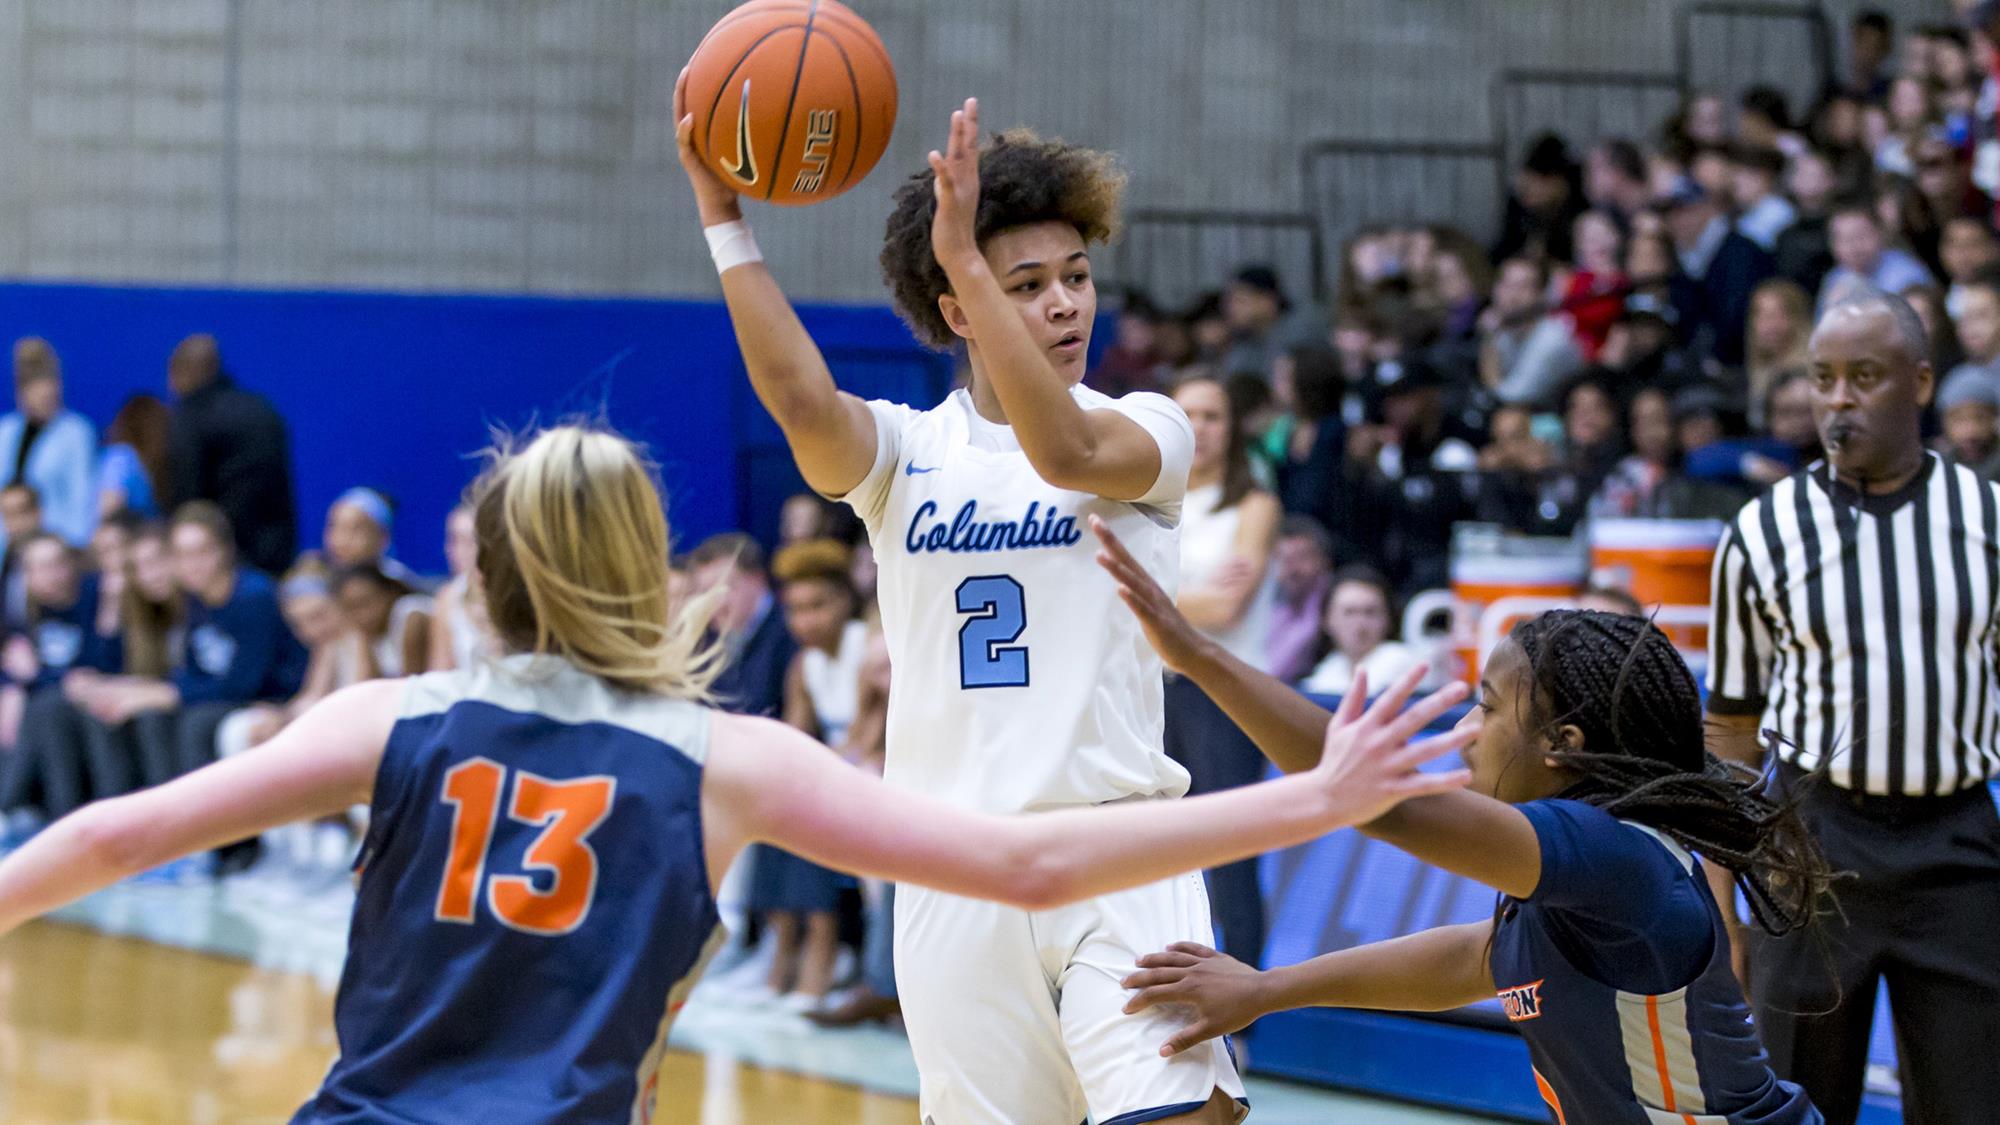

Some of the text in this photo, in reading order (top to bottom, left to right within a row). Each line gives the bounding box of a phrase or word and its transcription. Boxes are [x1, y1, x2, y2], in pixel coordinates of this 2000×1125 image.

[791, 109, 836, 193] ELITE
[906, 499, 1082, 554] Columbia
[955, 574, 1030, 690] 2
[434, 756, 617, 936] 13
